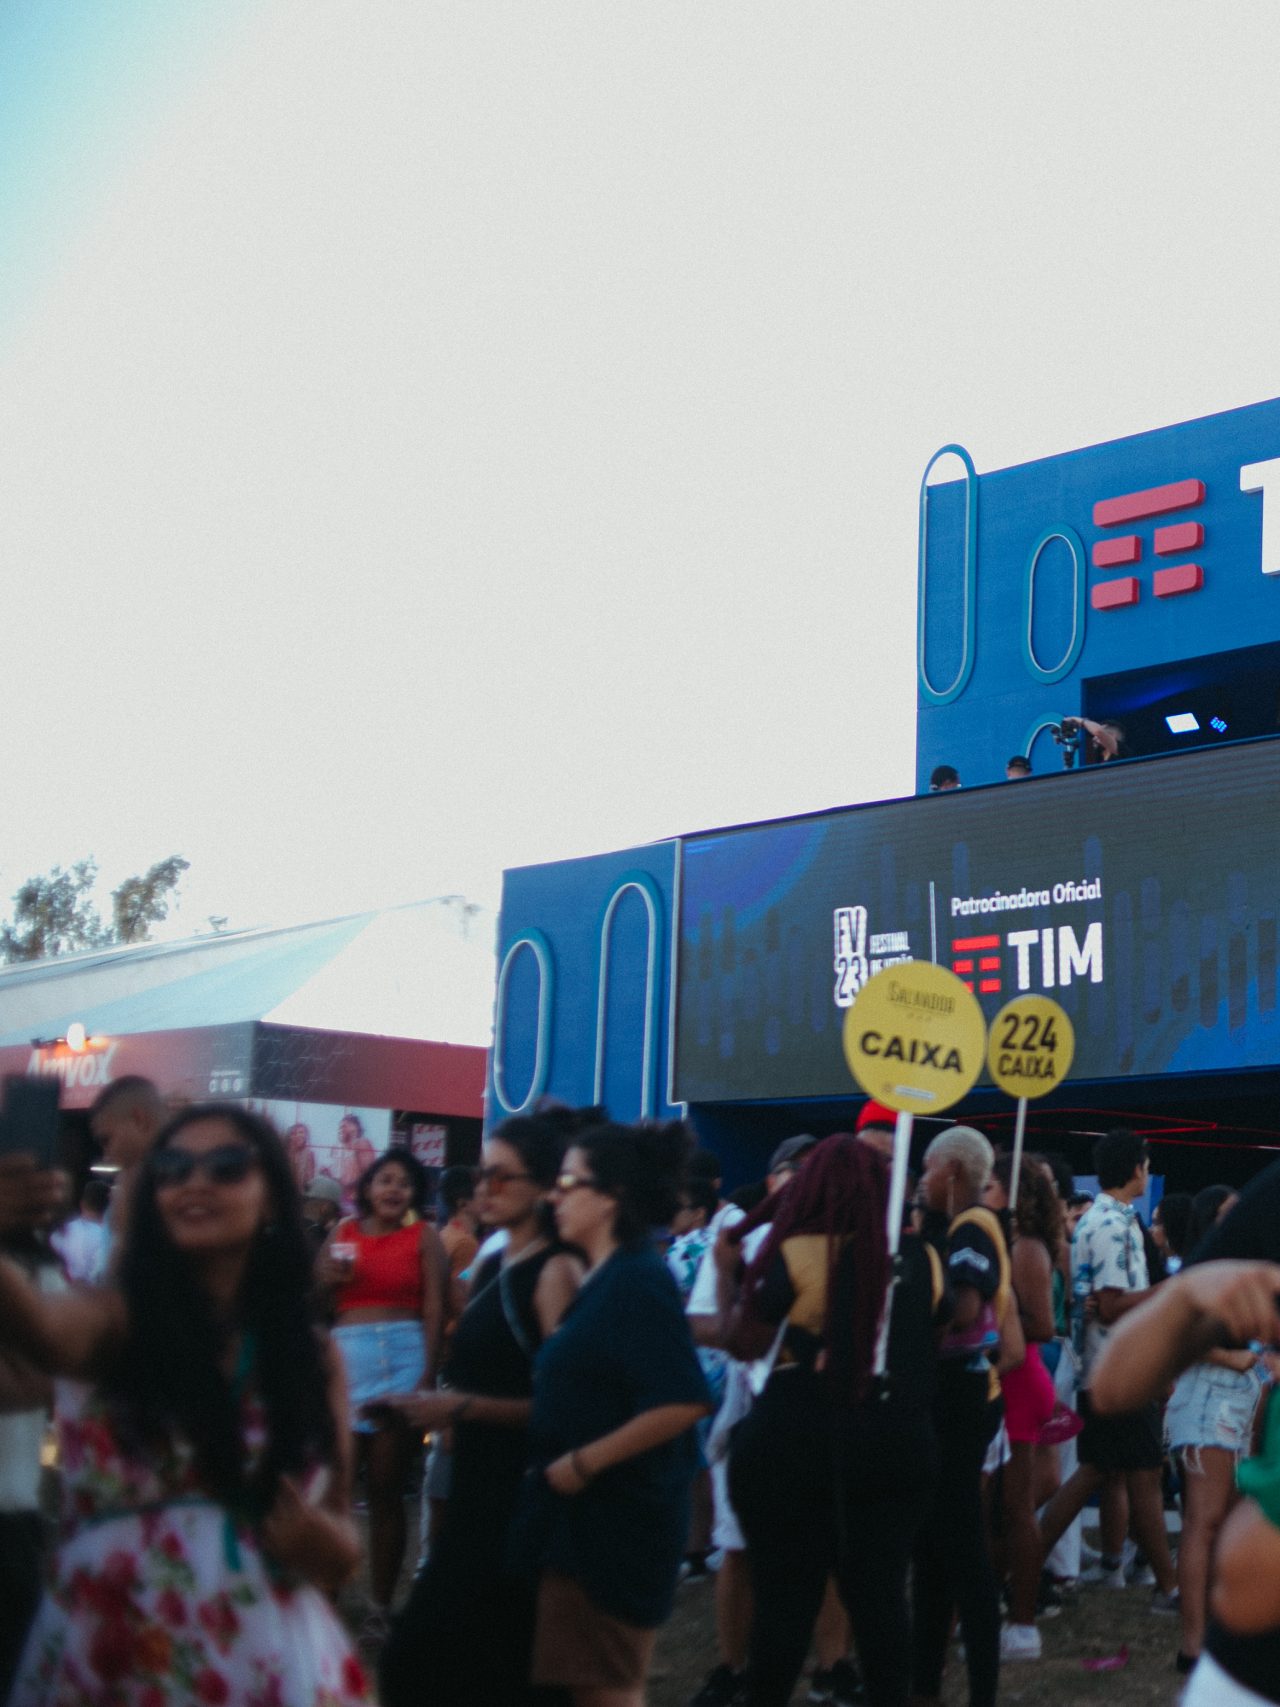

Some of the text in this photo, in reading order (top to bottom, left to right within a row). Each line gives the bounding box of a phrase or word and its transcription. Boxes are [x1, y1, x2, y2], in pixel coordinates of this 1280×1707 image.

[951, 877, 1102, 916] Patrocinadora Oficial
[1007, 922, 1103, 990] TIM
[861, 1030, 963, 1074] CAIXA
[1001, 1013, 1057, 1053] 224
[999, 1053, 1055, 1079] CAIXA
